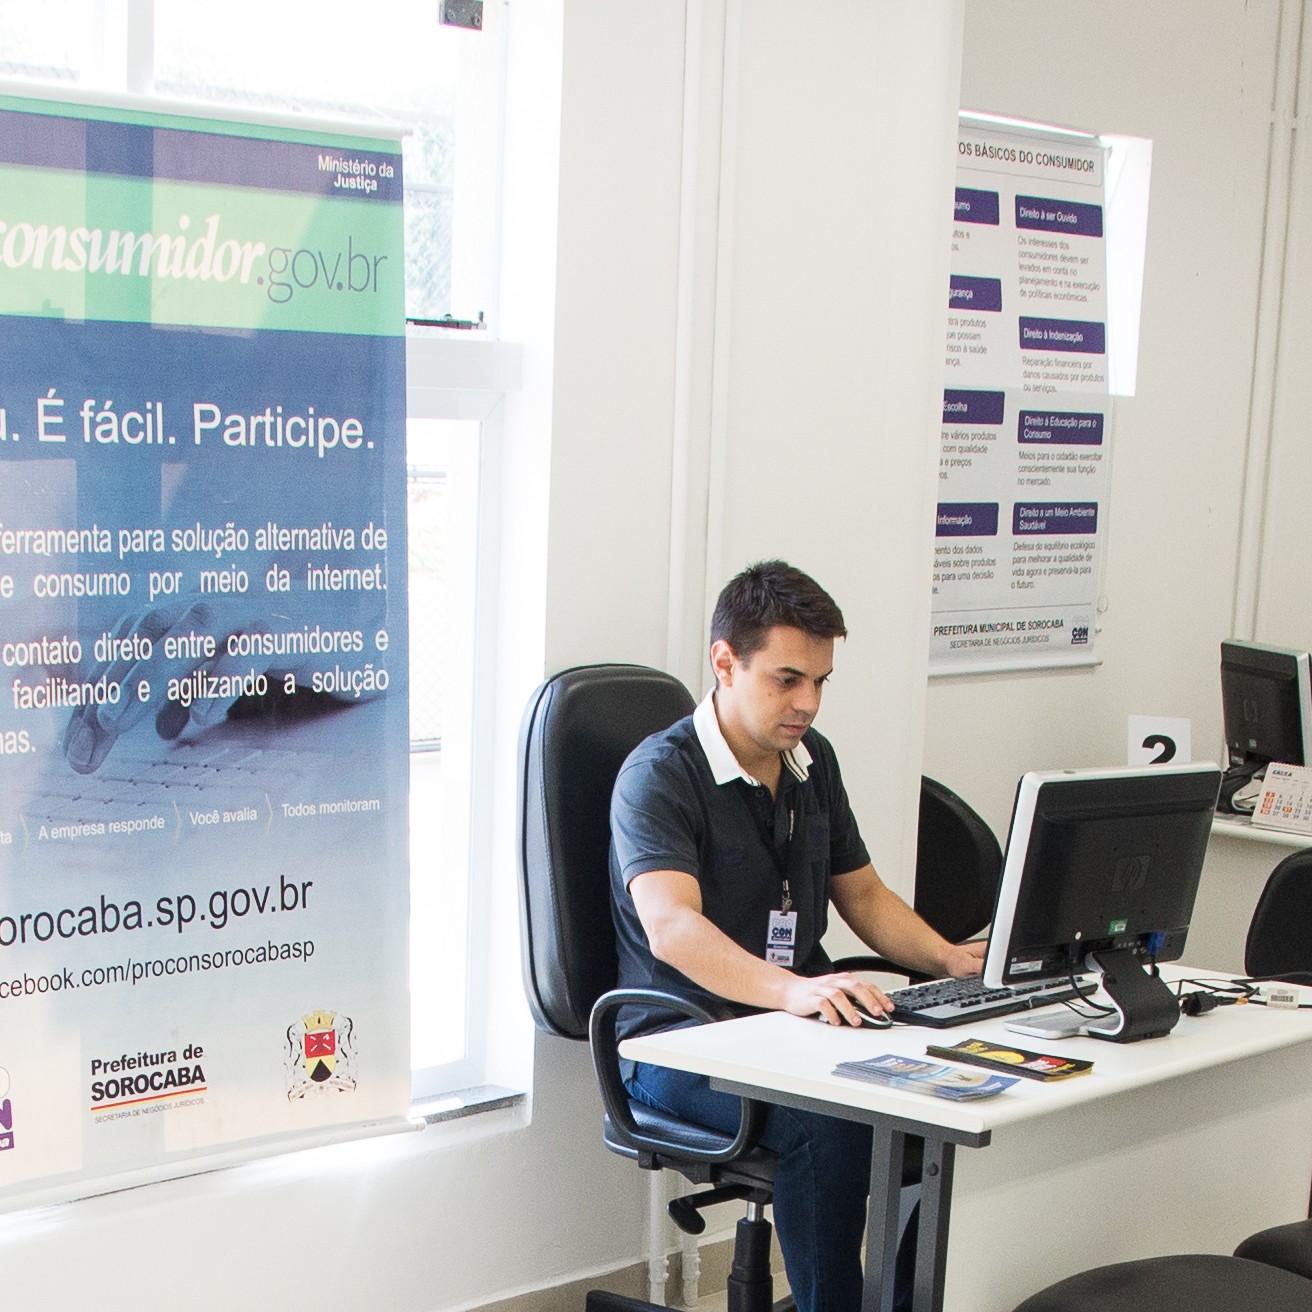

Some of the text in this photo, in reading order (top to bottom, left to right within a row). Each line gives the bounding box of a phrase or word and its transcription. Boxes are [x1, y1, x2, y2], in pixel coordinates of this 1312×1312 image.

[318, 154, 394, 178] Ministério da
[975, 142, 1016, 162] BÁSICOS
[1019, 150, 1034, 164] DO
[1036, 152, 1095, 173] CONSUMIDOR
[333, 173, 378, 194] Justiça
[1019, 206, 1039, 219] Direito
[1046, 212, 1056, 221] ser
[1056, 211, 1077, 224] Ouvido
[1023, 327, 1042, 339] Direito
[1049, 330, 1084, 343] Indenização
[37, 388, 66, 442] É
[80, 399, 177, 445] fácil.
[192, 403, 375, 458] Participe.
[1023, 428, 1051, 439] Consumo
[1024, 415, 1043, 427] Direito
[1050, 416, 1078, 428] Educação
[1079, 420, 1091, 430] para
[1019, 507, 1039, 518] Direito
[1054, 507, 1068, 517] Meio
[1069, 507, 1095, 517] Ambiente
[119, 528, 165, 559] para
[171, 522, 249, 558] solução
[255, 522, 355, 551] alternativa
[361, 522, 387, 550] de
[33, 572, 130, 597] consumo
[149, 571, 183, 602] por
[200, 563, 249, 593] meio
[266, 563, 291, 592] da
[307, 562, 387, 591] internet.
[933, 624, 978, 636] PREFEITURA
[979, 622, 1015, 633] MUNICIPAL
[1016, 620, 1026, 631] DE
[1028, 619, 1064, 630] SOROCABA
[2, 635, 82, 667] contato
[94, 631, 153, 662] direto
[164, 630, 216, 659] entre
[227, 625, 363, 656] consumidores
[375, 629, 388, 651] e
[949, 638, 984, 649] SECRETARIA
[12, 675, 121, 710] facilitando
[138, 680, 151, 702] e
[167, 668, 268, 707] agilizando
[283, 673, 296, 695] a
[312, 663, 389, 698] solução
[1142, 734, 1176, 764] 2
[190, 808, 257, 826] Você avalia
[281, 798, 380, 818] Todos monitoram
[38, 815, 165, 841] A empresa responde
[91, 1043, 204, 1076] Prefeitura de
[91, 1064, 205, 1102] SOROCABA
[94, 1110, 132, 1125] SECRETARIA
[132, 1108, 141, 1117] DE
